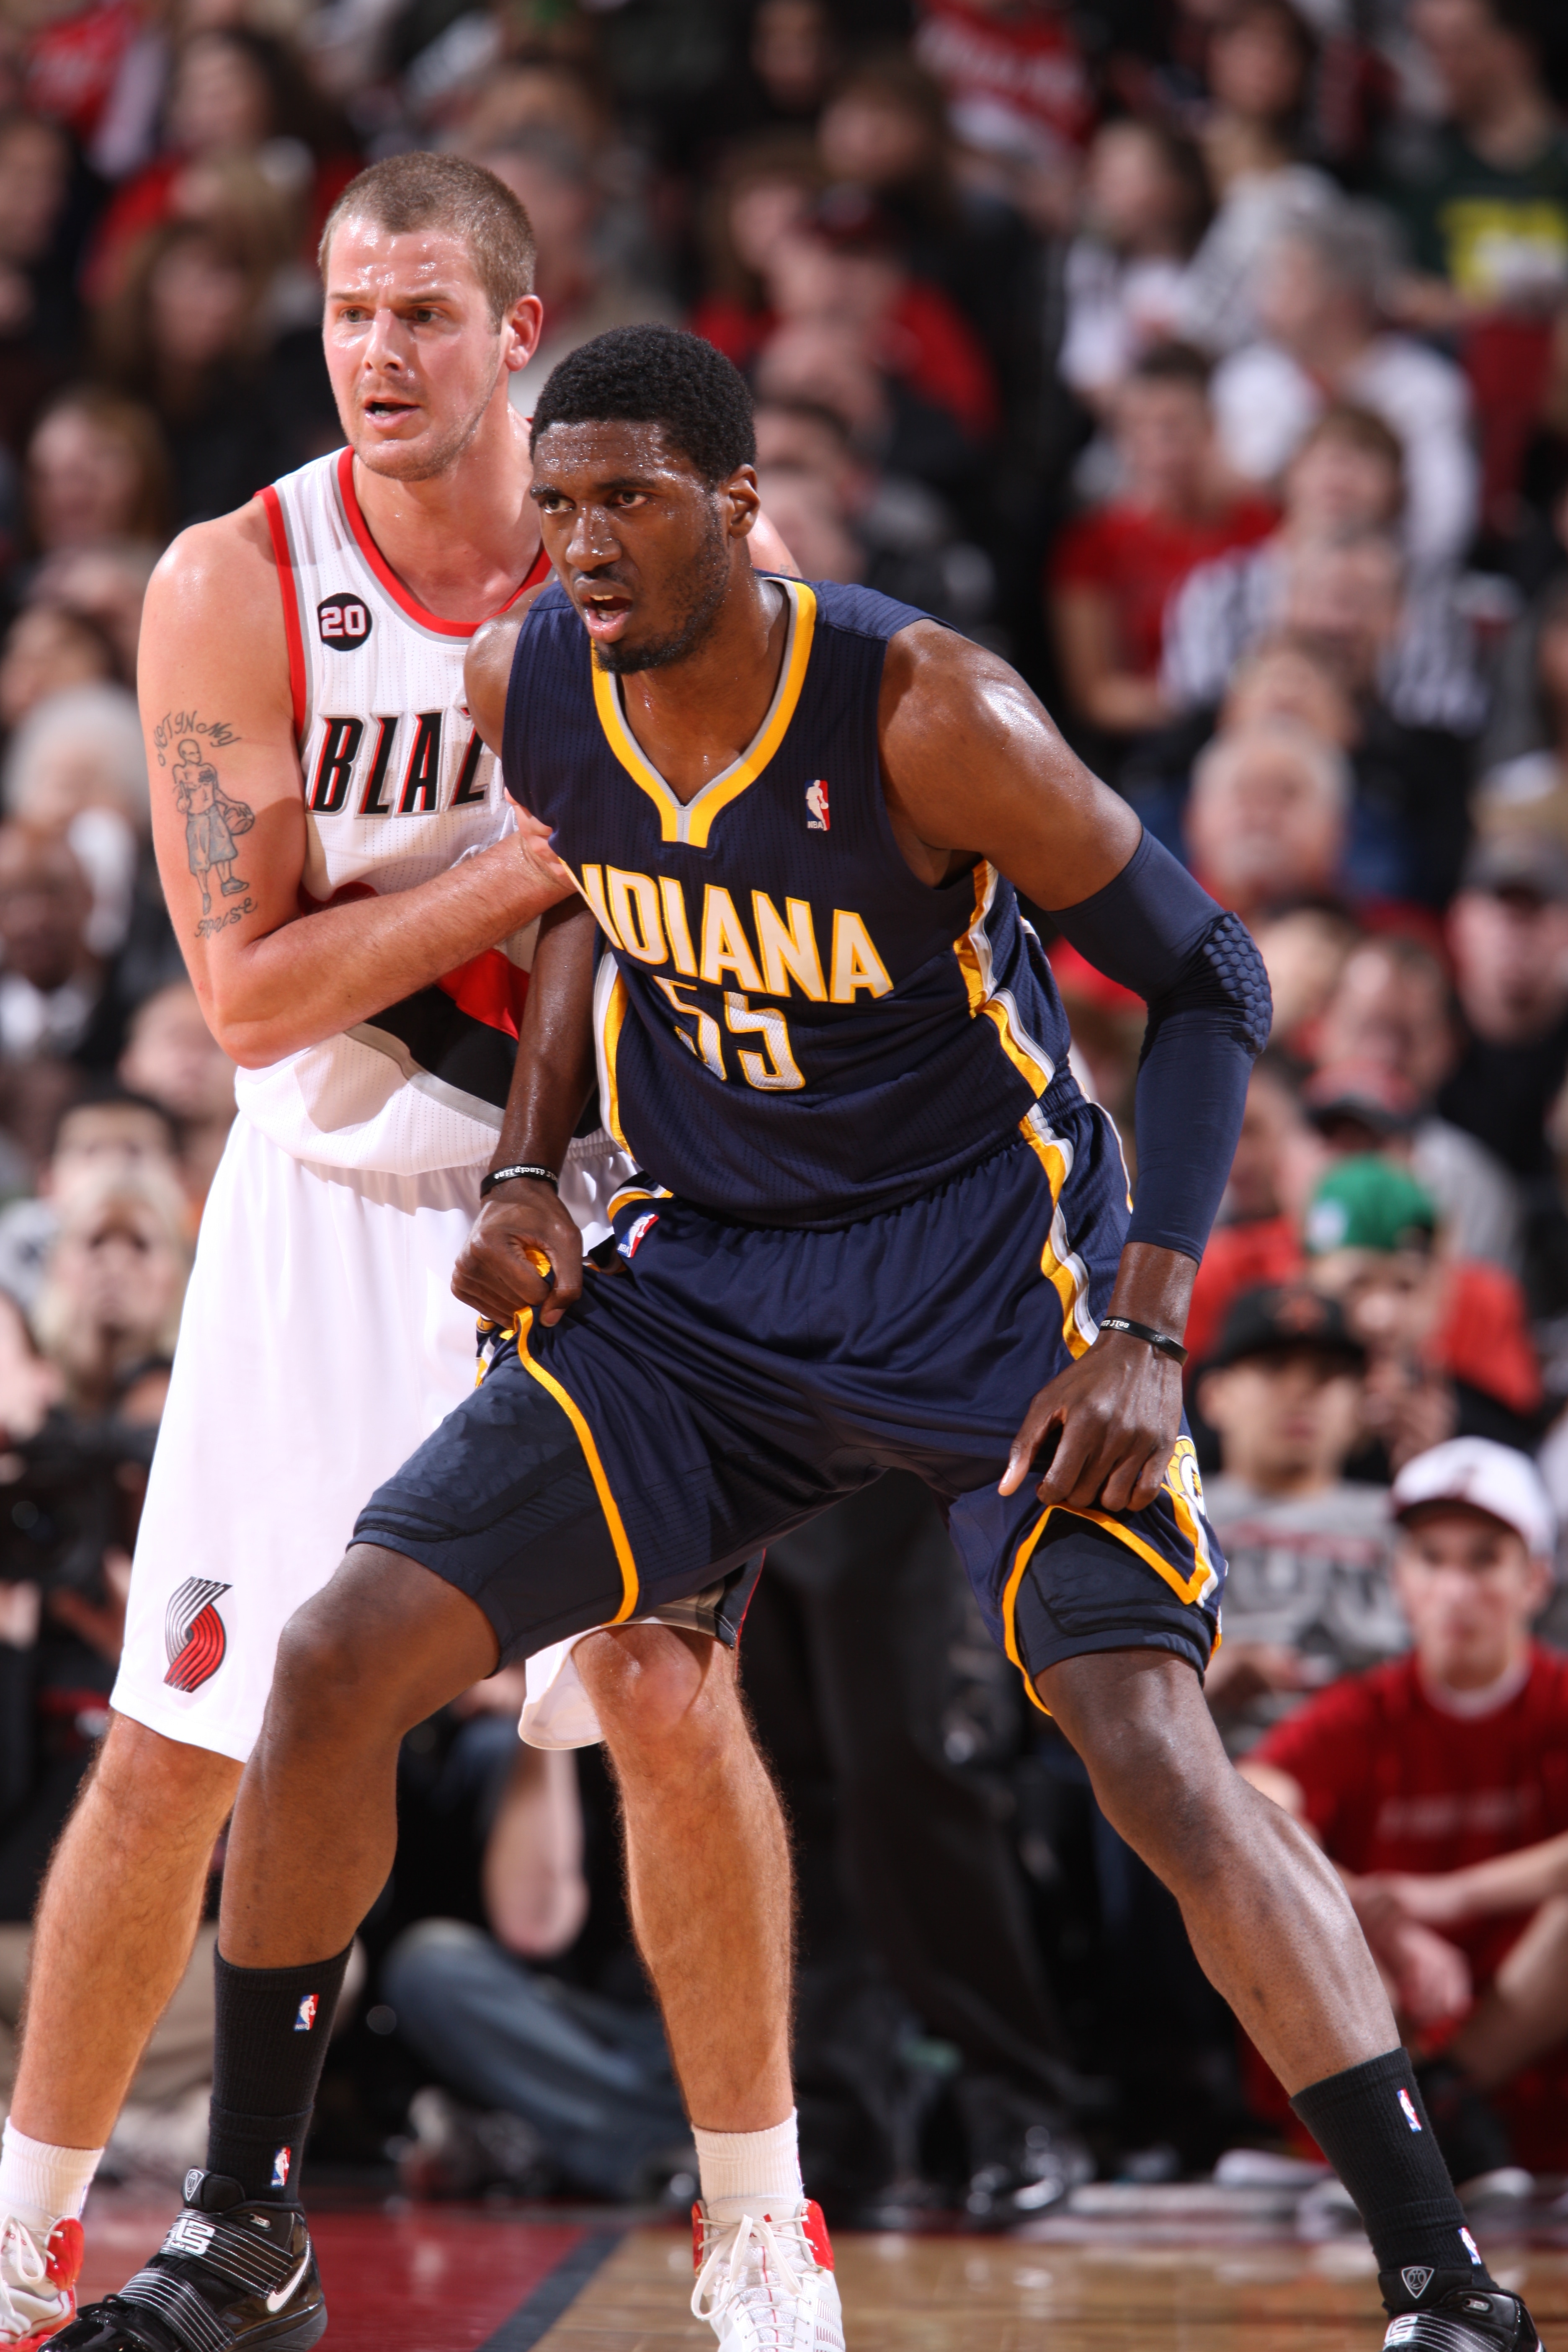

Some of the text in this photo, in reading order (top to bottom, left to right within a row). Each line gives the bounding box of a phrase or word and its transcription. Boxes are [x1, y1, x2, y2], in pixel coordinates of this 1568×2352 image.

[321, 604, 366, 638] 20
[306, 704, 489, 819] BLAZ
[559, 856, 893, 1004] NDIANA
[652, 975, 806, 1091] 55
[617, 1243, 630, 1254] NBA
[1110, 1320, 1130, 1328] self
